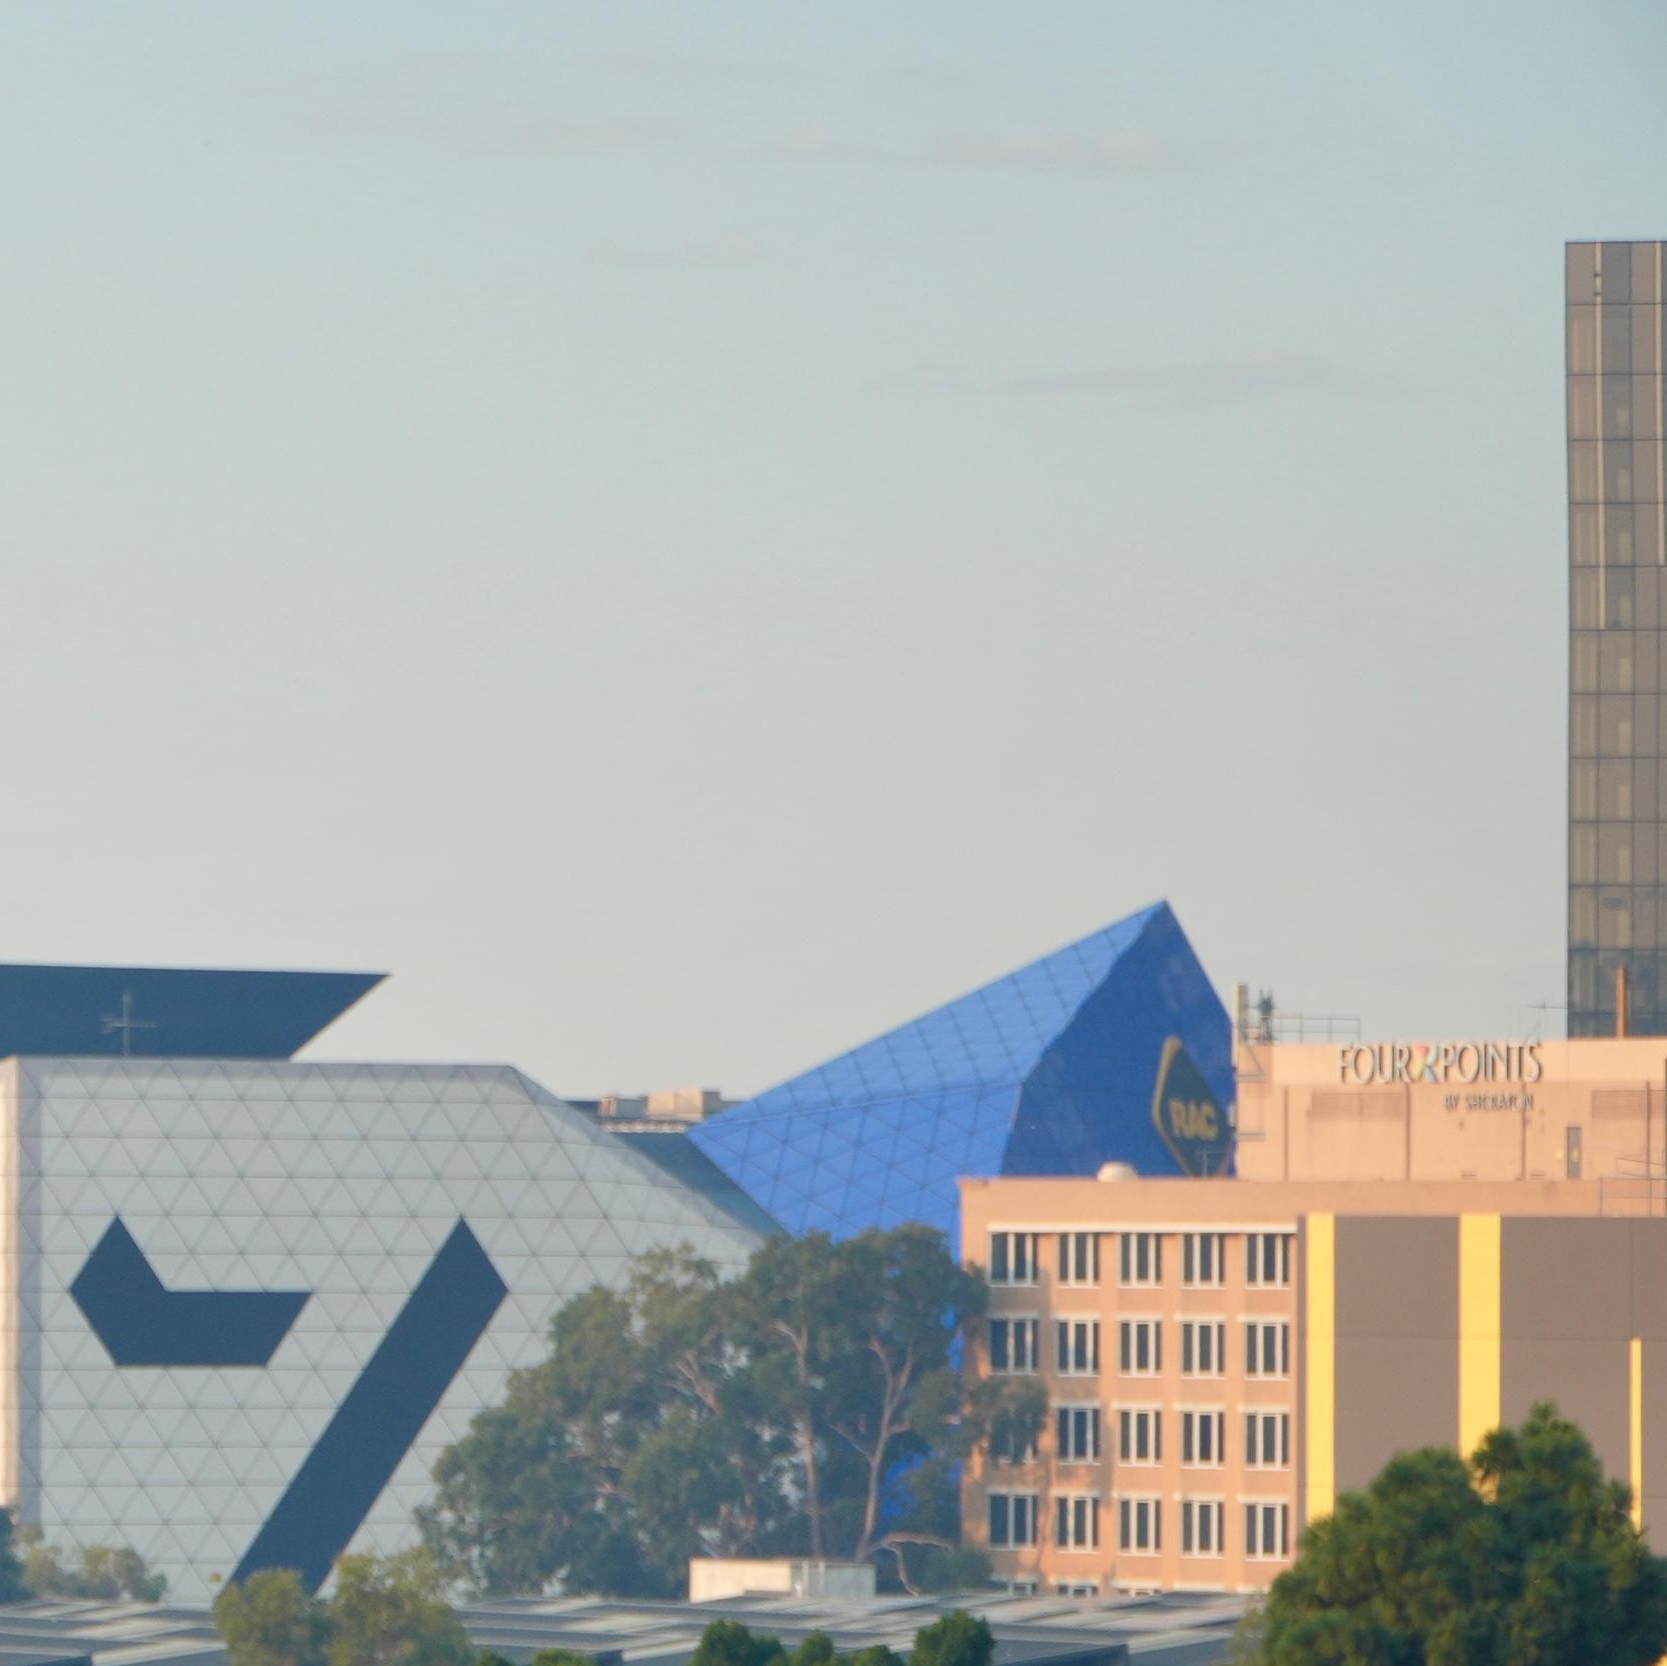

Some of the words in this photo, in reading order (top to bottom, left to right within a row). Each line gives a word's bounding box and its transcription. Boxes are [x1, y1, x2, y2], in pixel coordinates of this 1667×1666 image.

[1339, 1042, 1418, 1085] FOUR
[1443, 1037, 1543, 1084] POINTS
[1170, 1098, 1218, 1140] RAC
[1465, 1093, 1534, 1112] SHERATN
